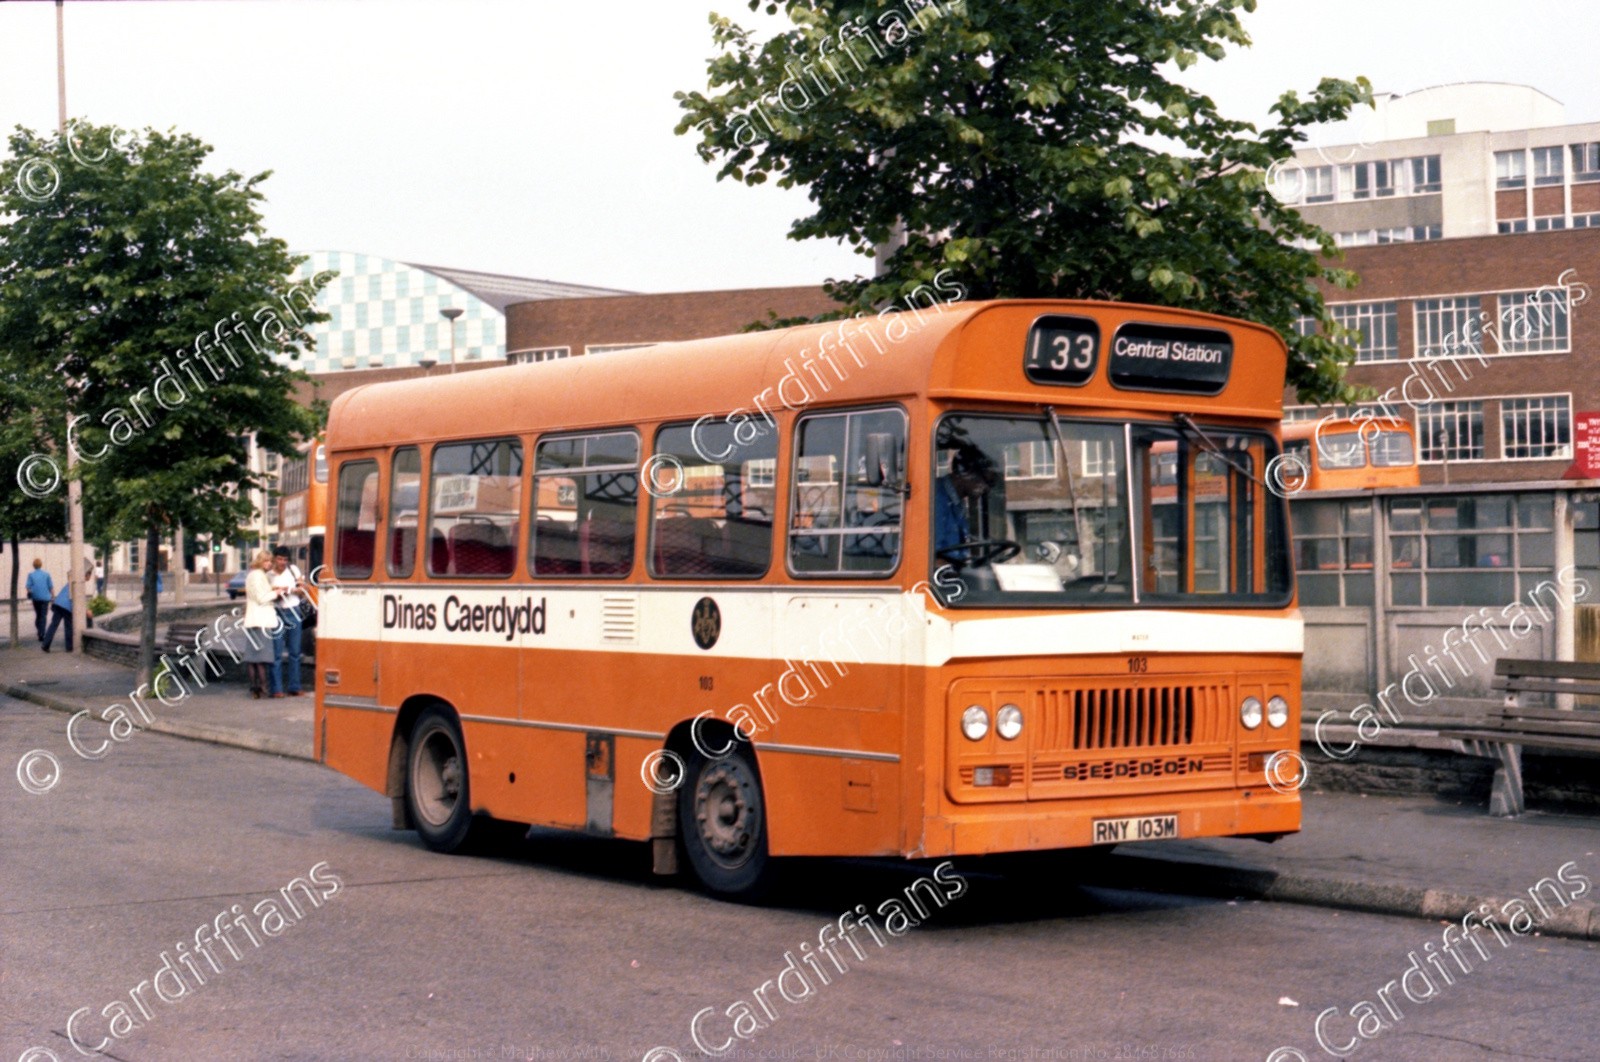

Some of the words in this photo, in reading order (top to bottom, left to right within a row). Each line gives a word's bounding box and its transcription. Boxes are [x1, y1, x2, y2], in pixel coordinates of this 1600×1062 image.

[1115, 337, 1170, 359] Central
[1171, 341, 1222, 363] Station
[383, 594, 437, 631] Dinas
[443, 595, 547, 641] Caerdydd
[1127, 657, 1148, 673] 103
[699, 675, 714, 691] 103
[1063, 760, 1203, 780] SEDDON
[1096, 820, 1130, 842] RNY
[1137, 817, 1176, 839] 103M
